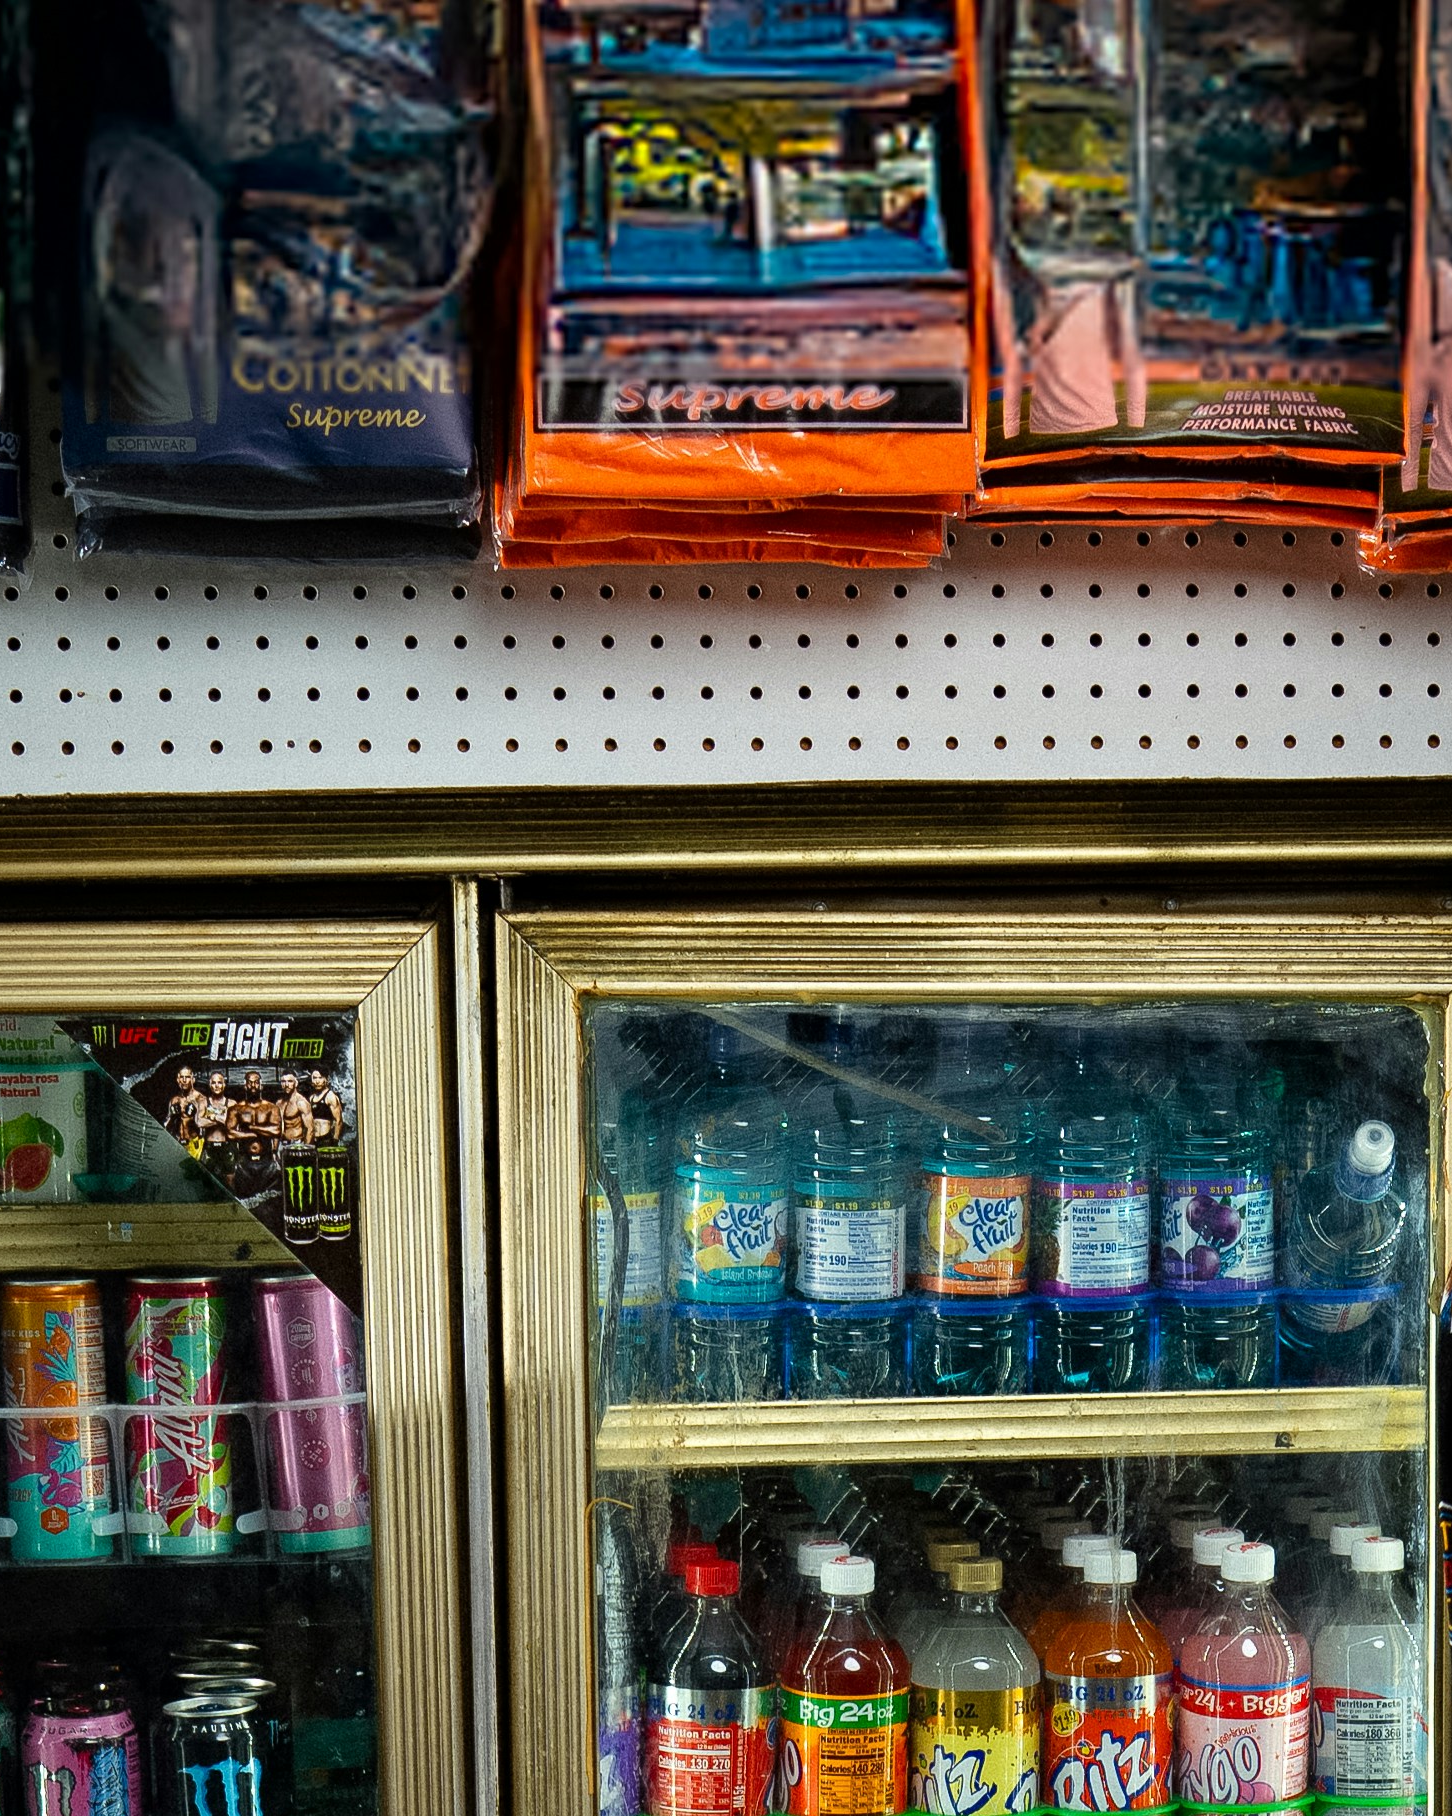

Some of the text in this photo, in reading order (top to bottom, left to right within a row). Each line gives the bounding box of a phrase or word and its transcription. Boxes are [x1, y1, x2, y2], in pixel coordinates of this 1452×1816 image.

[614, 378, 897, 422] Supreme
[1223, 390, 1318, 403] BREATHABLE
[1192, 403, 1347, 419] MOISTURE WICKING
[285, 402, 427, 437] Supreme
[1180, 417, 1360, 435] PERFORMANCE FABRIC
[119, 1026, 160, 1045] UFC
[183, 1025, 210, 1045] IT'S
[209, 1021, 289, 1061] FIGHT
[285, 1039, 323, 1059] TIME!
[35, 1074, 60, 1085] rosa
[0, 1087, 41, 1098] Natural
[712, 1200, 772, 1233] Clear
[958, 1196, 1016, 1227] Clear
[1072, 1206, 1111, 1216] Nutrition
[805, 1216, 841, 1227] Nutrition
[726, 1215, 773, 1258] fruit
[972, 1211, 1018, 1255] fruit
[1099, 1242, 1118, 1254] 190
[828, 1254, 847, 1266] 190
[973, 1262, 996, 1274] Peach
[721, 1268, 745, 1281] Island
[151, 1335, 213, 1477] Alani
[1098, 1685, 1116, 1701] 24
[1194, 1690, 1216, 1712] 24
[687, 1703, 706, 1720] 24
[1242, 1691, 1306, 1716] Bigger
[1336, 1699, 1401, 1710] Nutrition Facts
[799, 1700, 876, 1728] Big 24
[658, 1725, 731, 1740] Nutrition Facts
[820, 1734, 886, 1745] Nutrition Facts
[1365, 1727, 1401, 1739] 180 360
[690, 1757, 731, 1770] 130 270
[820, 1762, 869, 1775] Calories 140
